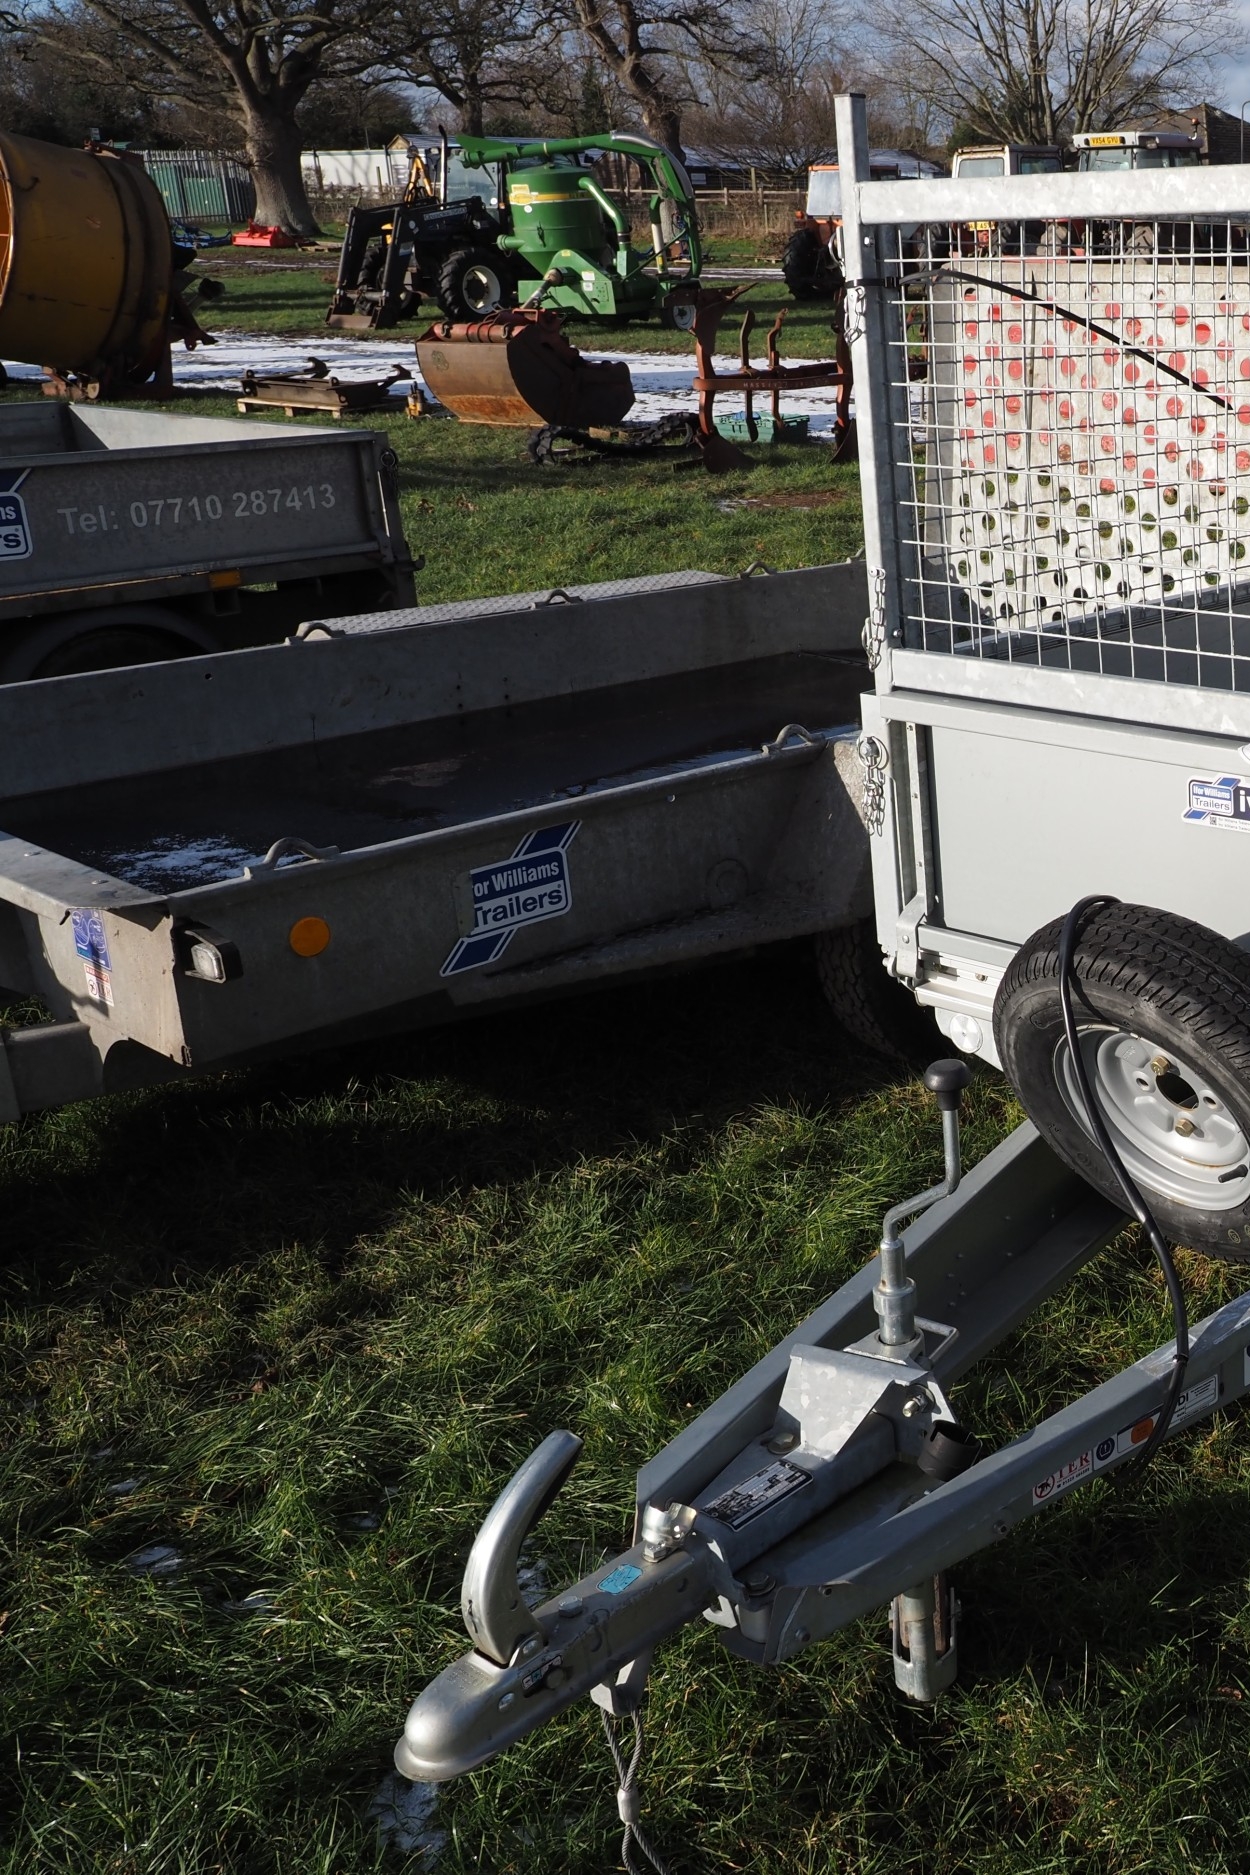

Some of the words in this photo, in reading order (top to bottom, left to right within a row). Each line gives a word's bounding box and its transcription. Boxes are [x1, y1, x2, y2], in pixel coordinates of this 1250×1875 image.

[57, 506, 120, 535] Tel:
[130, 493, 223, 528] 07710
[234, 484, 336, 518] 287413
[1194, 797, 1230, 811] Trailers
[491, 861, 560, 892] Williams
